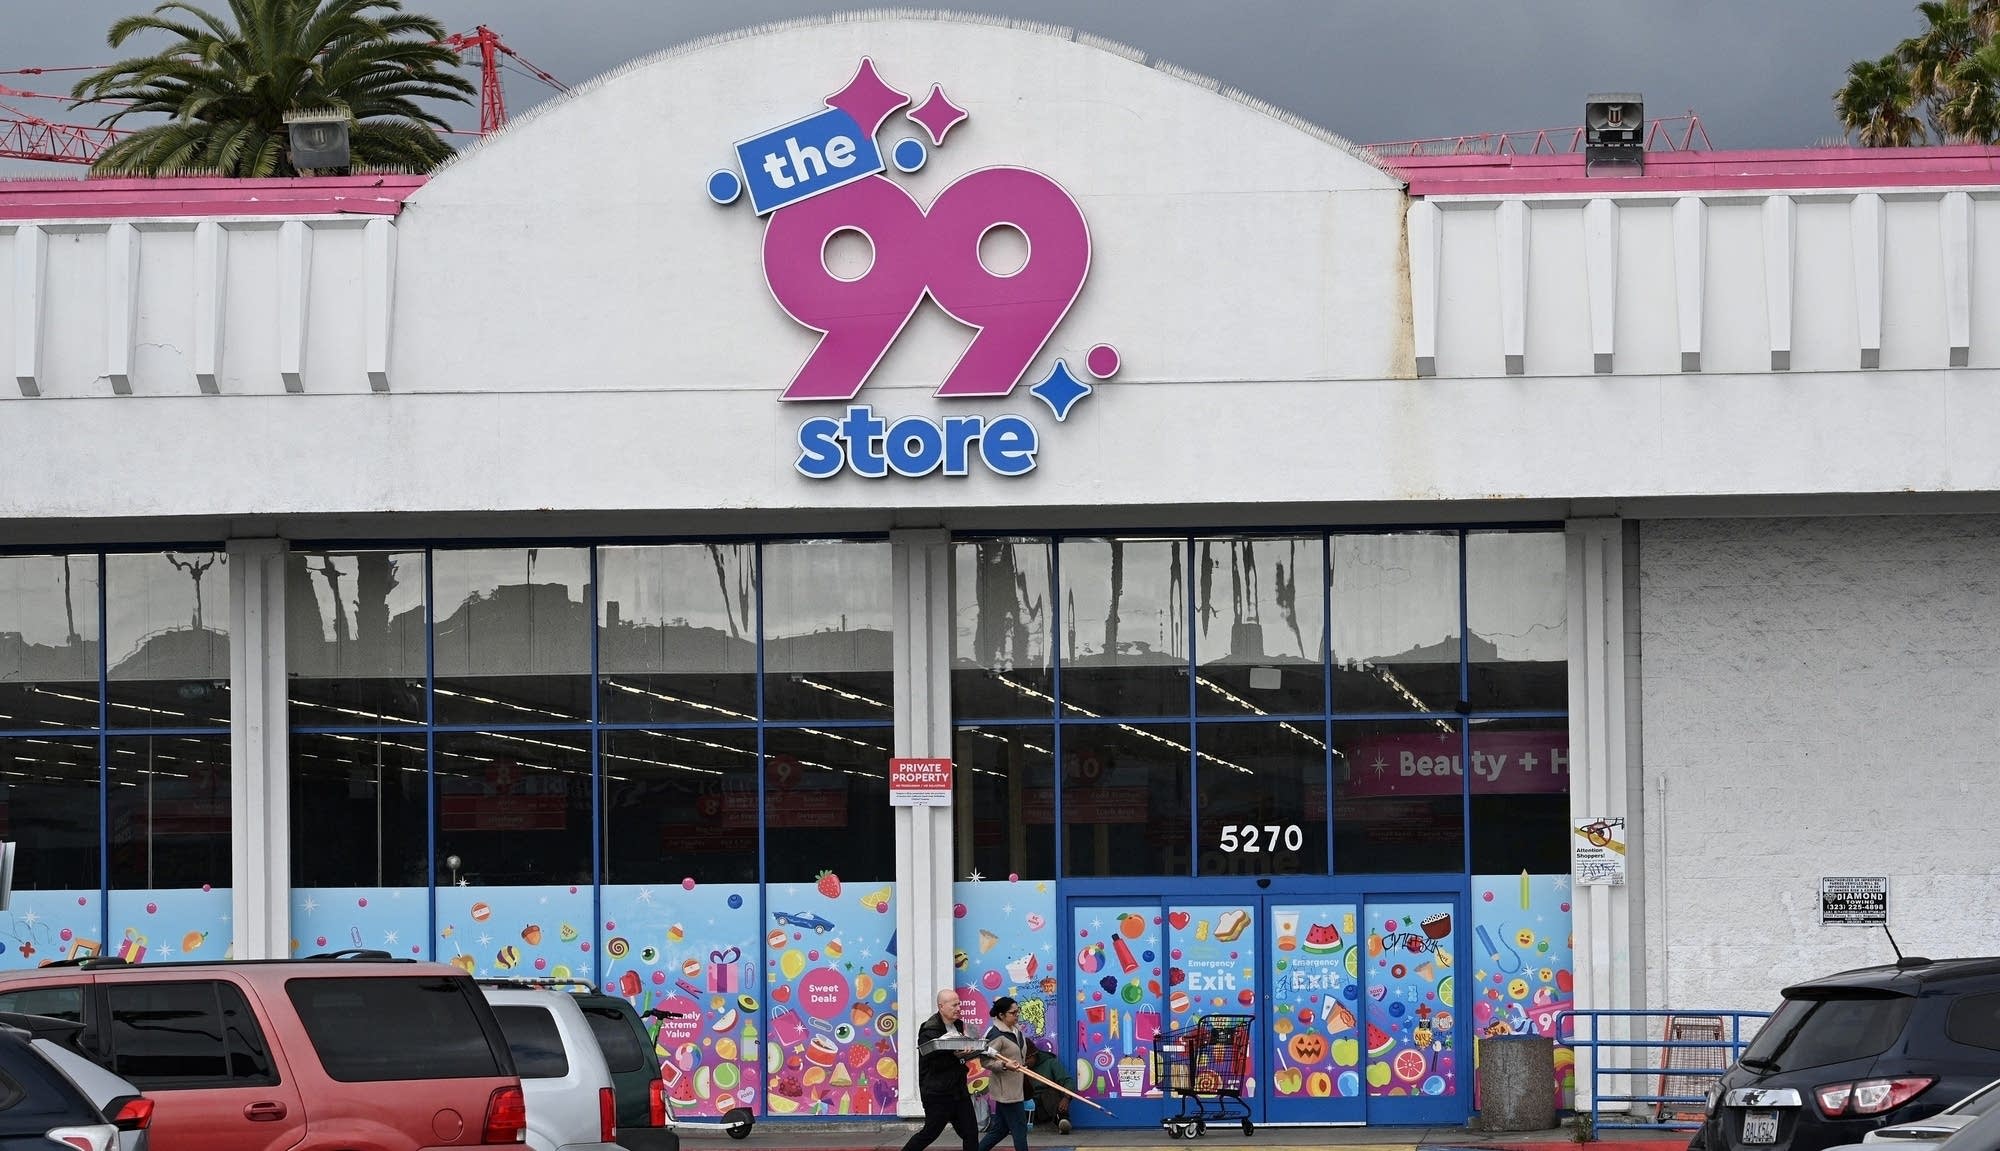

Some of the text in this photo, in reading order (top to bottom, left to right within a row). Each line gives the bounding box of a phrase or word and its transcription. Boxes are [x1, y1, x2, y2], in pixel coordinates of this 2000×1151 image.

[763, 136, 856, 188] the
[762, 165, 1092, 400] 99
[794, 404, 1038, 478] store
[900, 763, 942, 772] PRIVATE
[1401, 750, 1506, 782] Beauty
[892, 773, 949, 782] PROPERTY
[1219, 825, 1303, 853] 5270
[1188, 960, 1235, 968] Emergency
[1292, 960, 1339, 968] Emergency
[1188, 969, 1236, 990] Exit
[1292, 968, 1340, 989] Exit
[809, 984, 839, 992] Sweet
[811, 994, 837, 1002] Deals
[666, 1029, 691, 1038] Value
